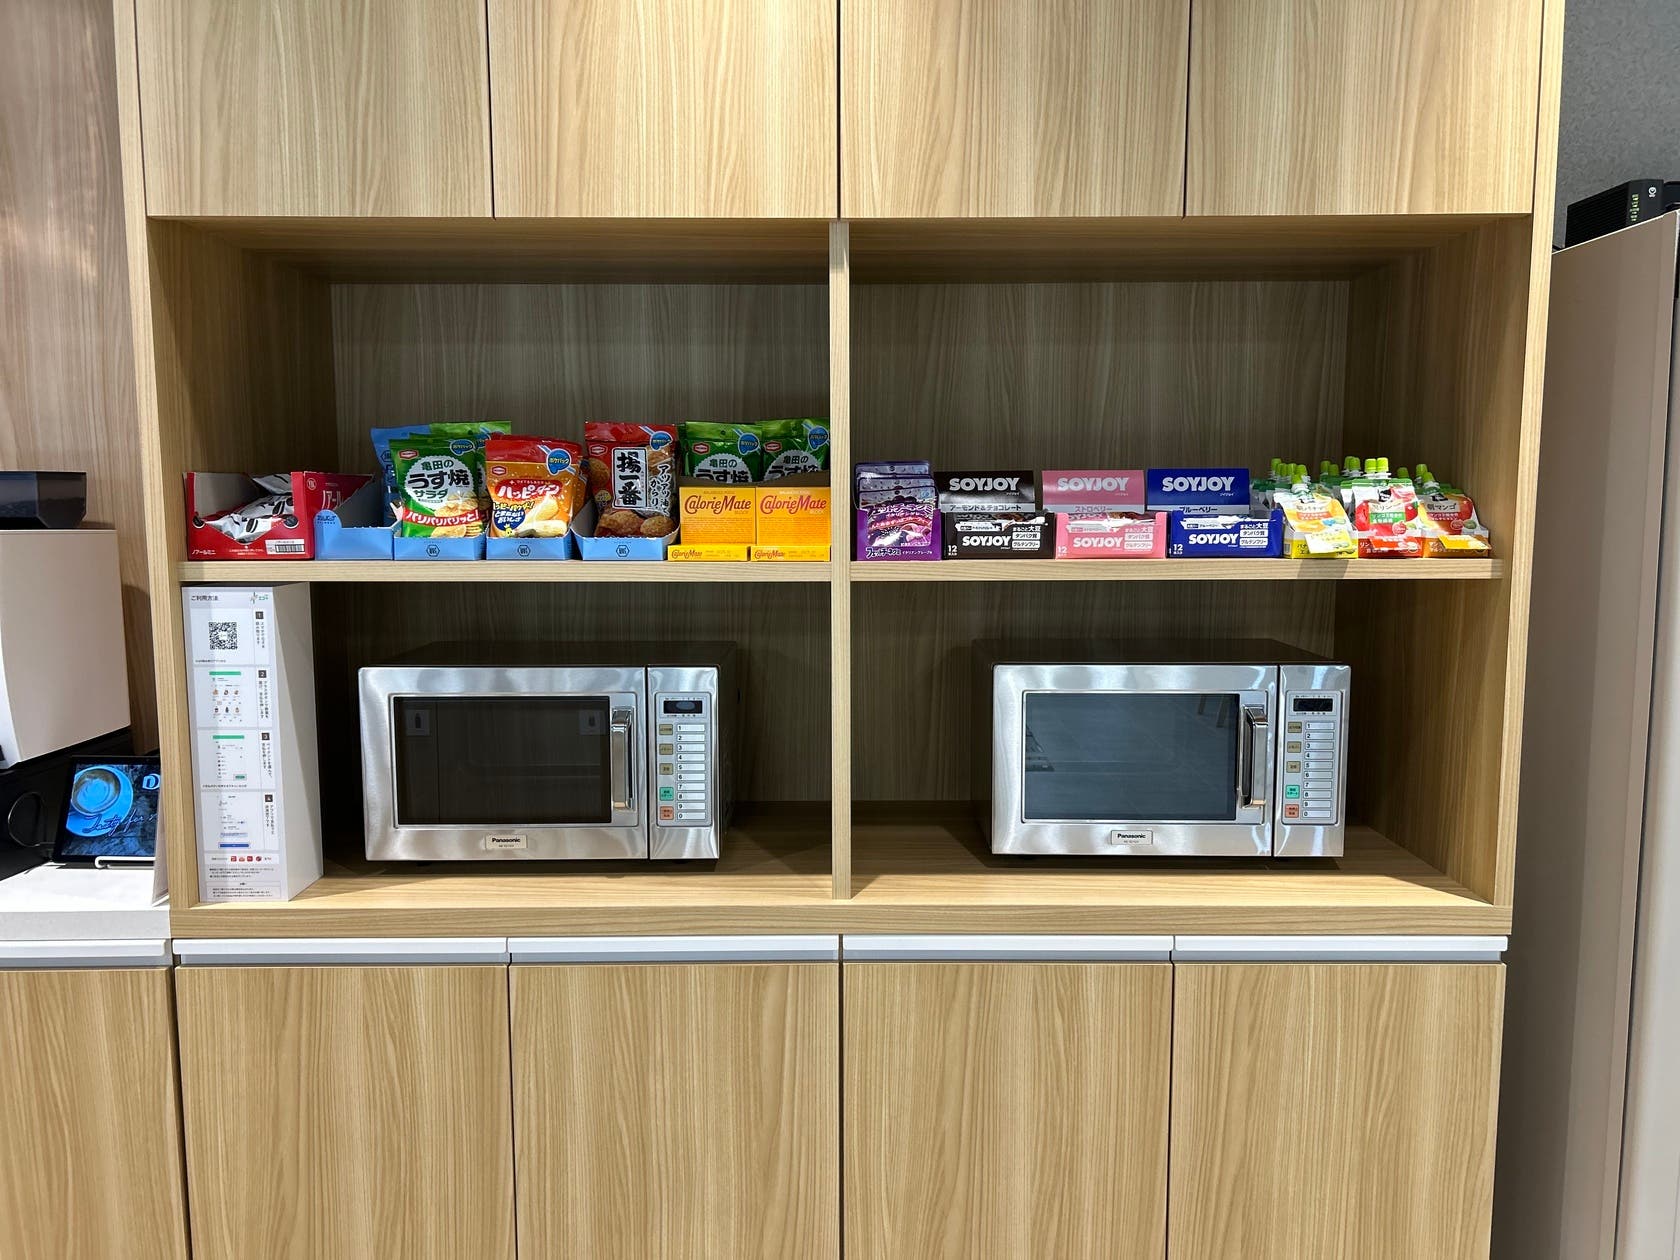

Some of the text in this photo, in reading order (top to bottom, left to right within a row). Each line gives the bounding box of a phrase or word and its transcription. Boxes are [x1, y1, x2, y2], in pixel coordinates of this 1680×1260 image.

[421, 459, 454, 471] 亀田の
[709, 458, 738, 468] 亀田の
[783, 455, 809, 464] 亀田の
[407, 468, 470, 490] うす焼
[616, 451, 642, 506] 揚一番
[949, 477, 1020, 491] SOYJOY
[1057, 477, 1129, 491] SOYJOY
[1162, 476, 1235, 492] SOYJOY
[413, 488, 449, 499] サラダ
[497, 483, 560, 499] ハッピーターン
[684, 494, 752, 515] CalorieMate
[760, 494, 827, 515] CalorieMate
[1075, 505, 1113, 513] ストロベリー
[962, 535, 1012, 547] SOYJOY
[1073, 536, 1123, 548] SOYJOY
[1188, 533, 1239, 545] SOYJOY
[1173, 543, 1183, 551] 12
